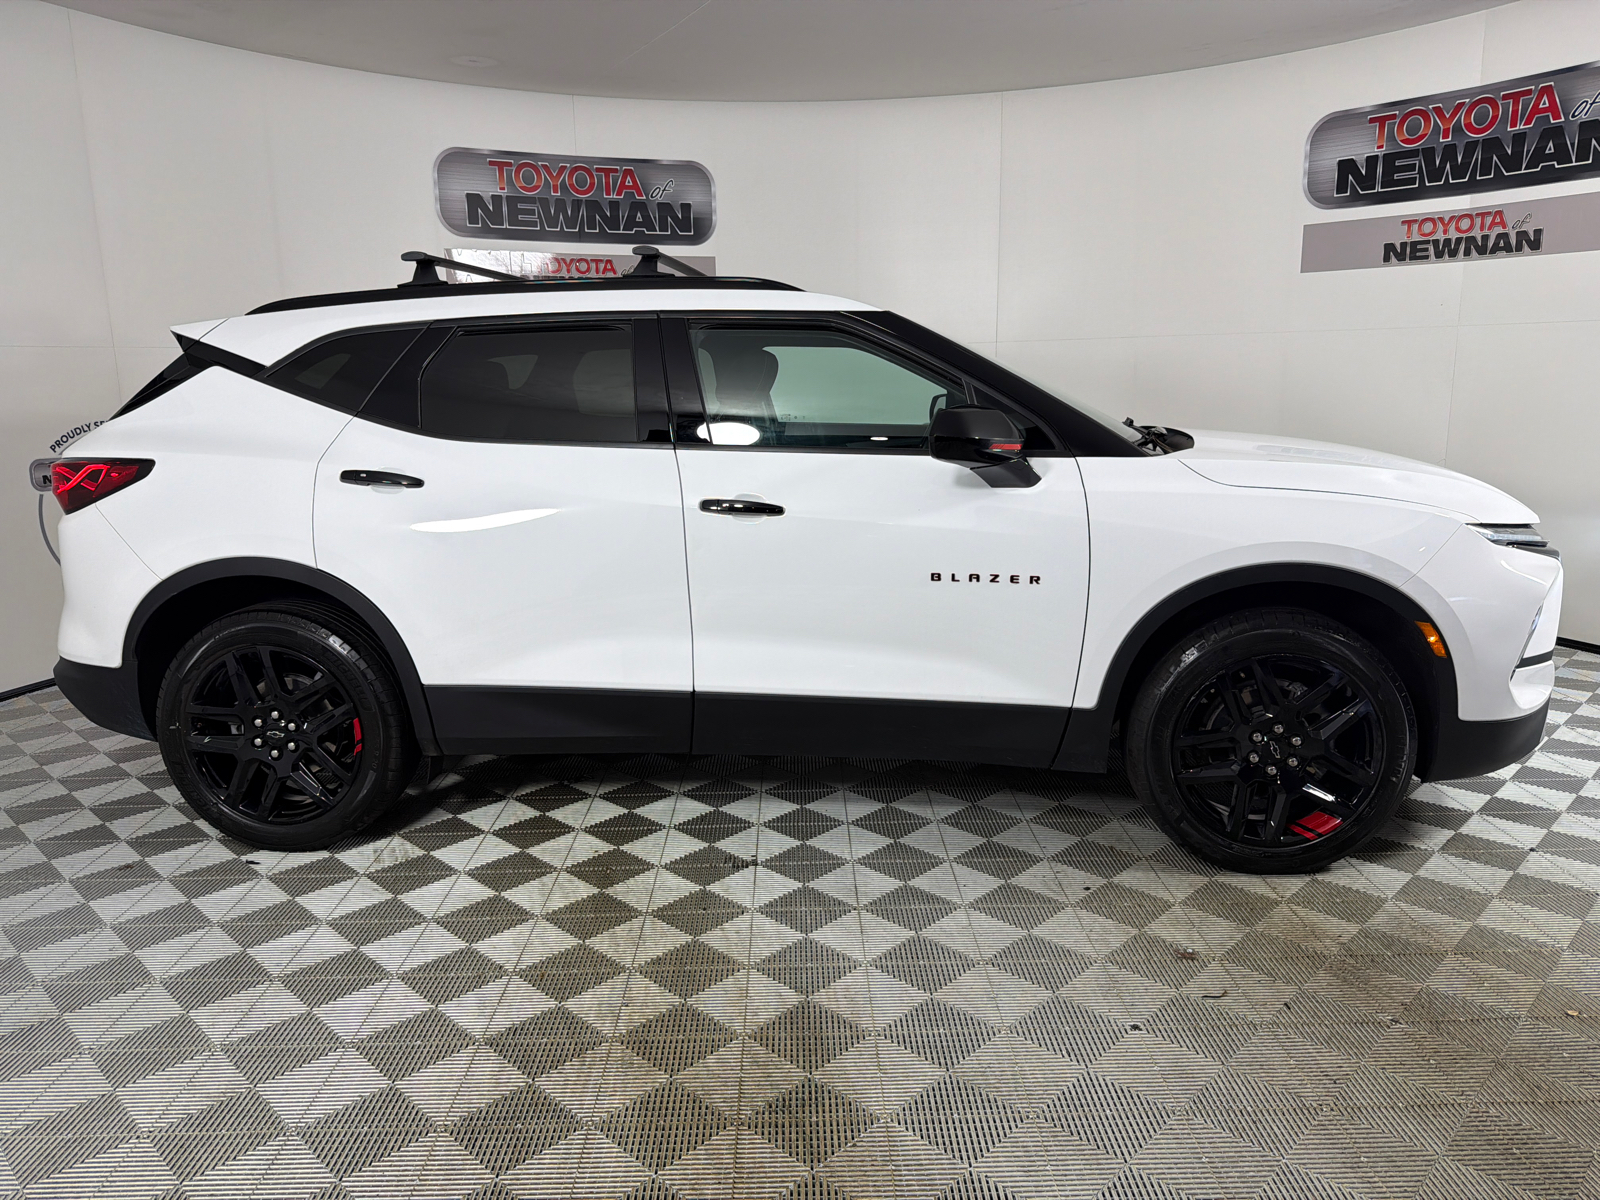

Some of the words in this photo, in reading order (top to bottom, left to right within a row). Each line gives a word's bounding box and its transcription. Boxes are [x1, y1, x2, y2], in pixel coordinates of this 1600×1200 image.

[1368, 82, 1565, 151] TOYOTA
[1569, 90, 1600, 120] of
[487, 159, 646, 199] TOYOTA
[649, 179, 674, 199] of
[465, 192, 694, 235] NEWNAN
[1401, 209, 1508, 239] TOYOTA
[1512, 212, 1532, 230] of
[1382, 227, 1544, 264] NEWNAN
[49, 423, 92, 453] PROUDLY
[930, 572, 1041, 585] BLAZER
